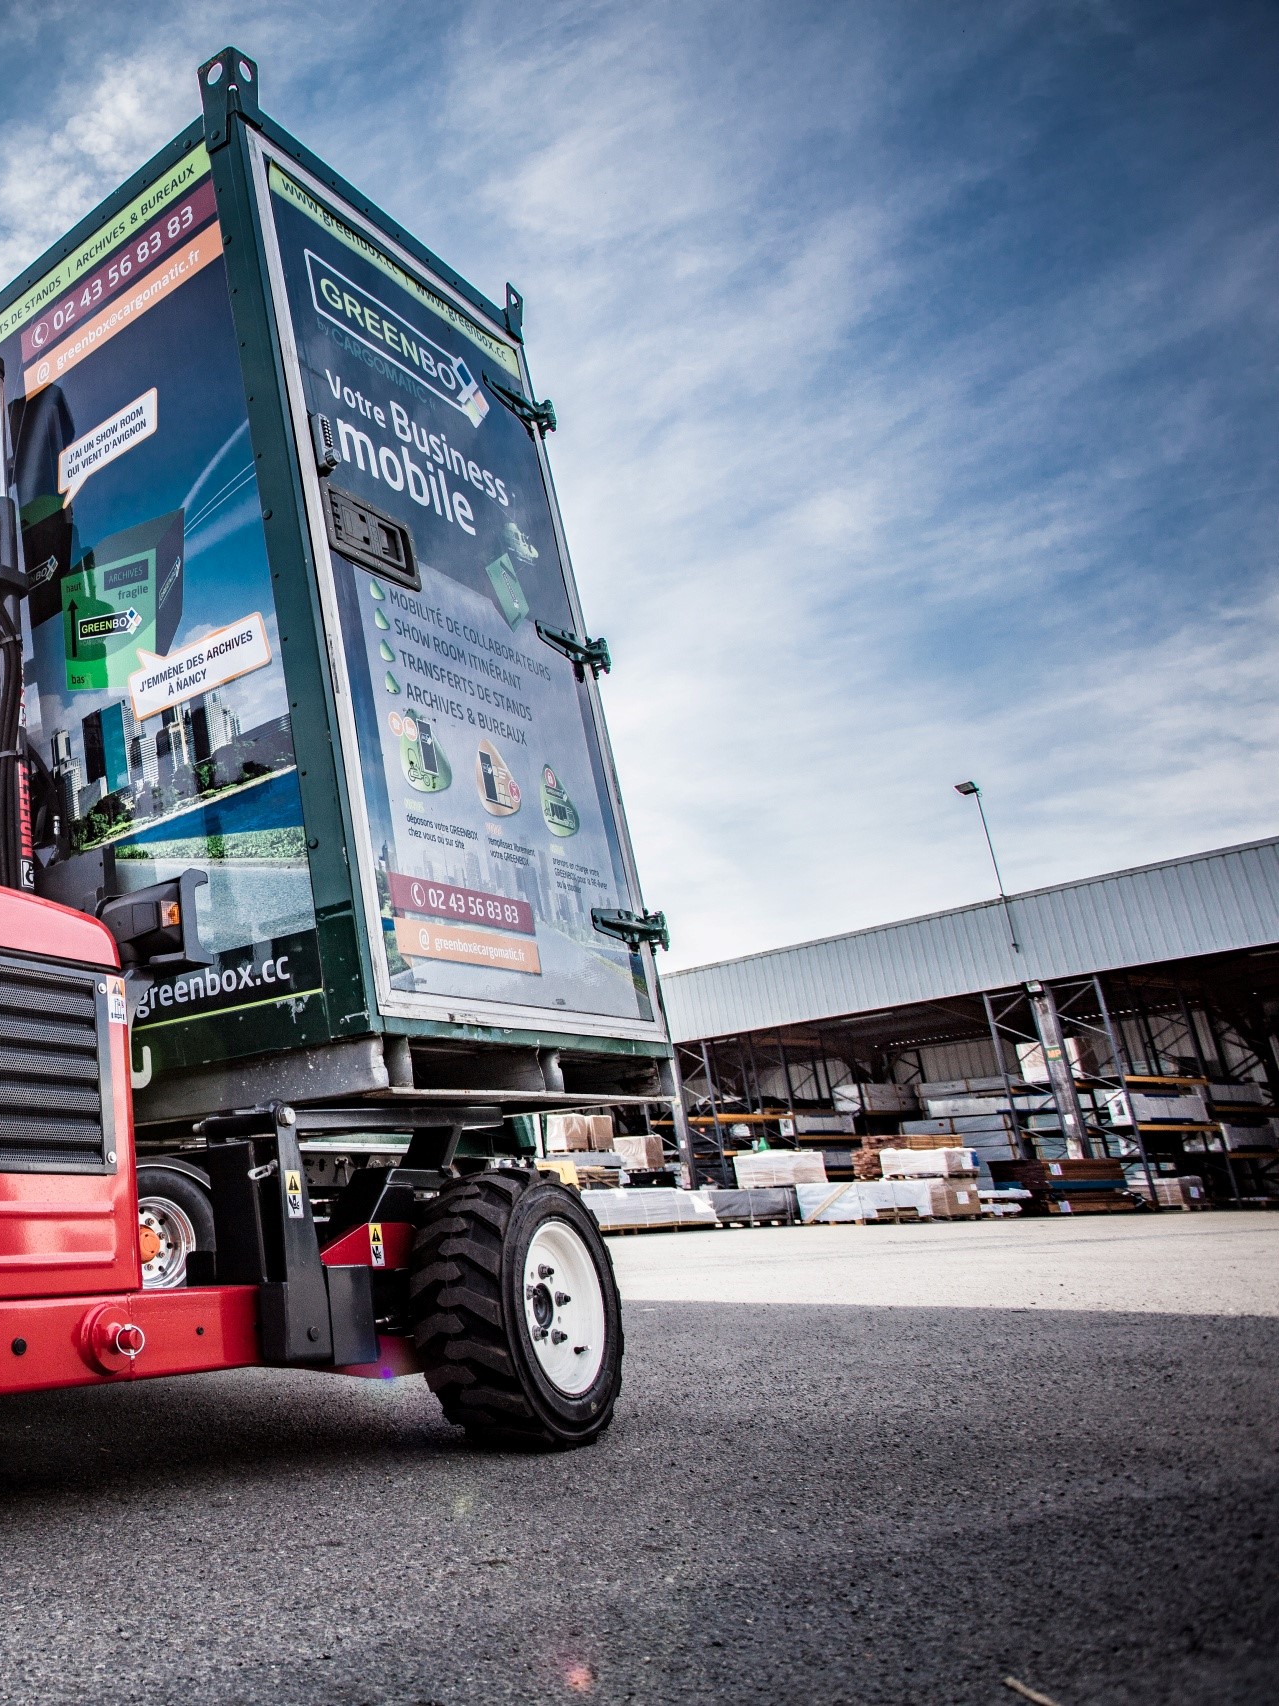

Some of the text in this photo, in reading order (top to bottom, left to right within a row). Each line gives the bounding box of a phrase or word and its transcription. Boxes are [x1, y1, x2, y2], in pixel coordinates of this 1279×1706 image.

[12, 308, 23, 324] DE
[24, 278, 61, 313] STANDS
[76, 224, 125, 271] ARCHIVES
[130, 213, 138, 224] &
[141, 164, 195, 217] BUREAUX
[53, 205, 193, 331] 02 43 56 83 83
[56, 250, 200, 370] greenbox@cargomatic.fr
[317, 317, 328, 335] by
[67, 418, 147, 479] QUI VIENT D'AVIGNON
[68, 406, 144, 465] J'AI UN SHOW ROOM
[325, 369, 509, 506] Votre Business
[336, 418, 476, 536] mobile
[66, 582, 82, 593] haut
[108, 566, 143, 584] ARCHIVES
[139, 630, 253, 693] J'EMMÈNE DES ARCHIVES
[389, 588, 551, 681] MOBILITÉ DE COLLABORATEURS
[394, 619, 521, 691] SHOW ROOM ITINÉRANT
[71, 675, 86, 685] bas
[168, 669, 207, 696] À NANCY
[399, 649, 533, 721] TRANSFERTS DE STANDS
[406, 682, 527, 747] ARCHIVES & BUREAUX
[428, 888, 519, 924] 02 43 56 83 83
[435, 938, 525, 961] greenbox@cargomatic.fr
[136, 956, 291, 1018] greenbox.cc
